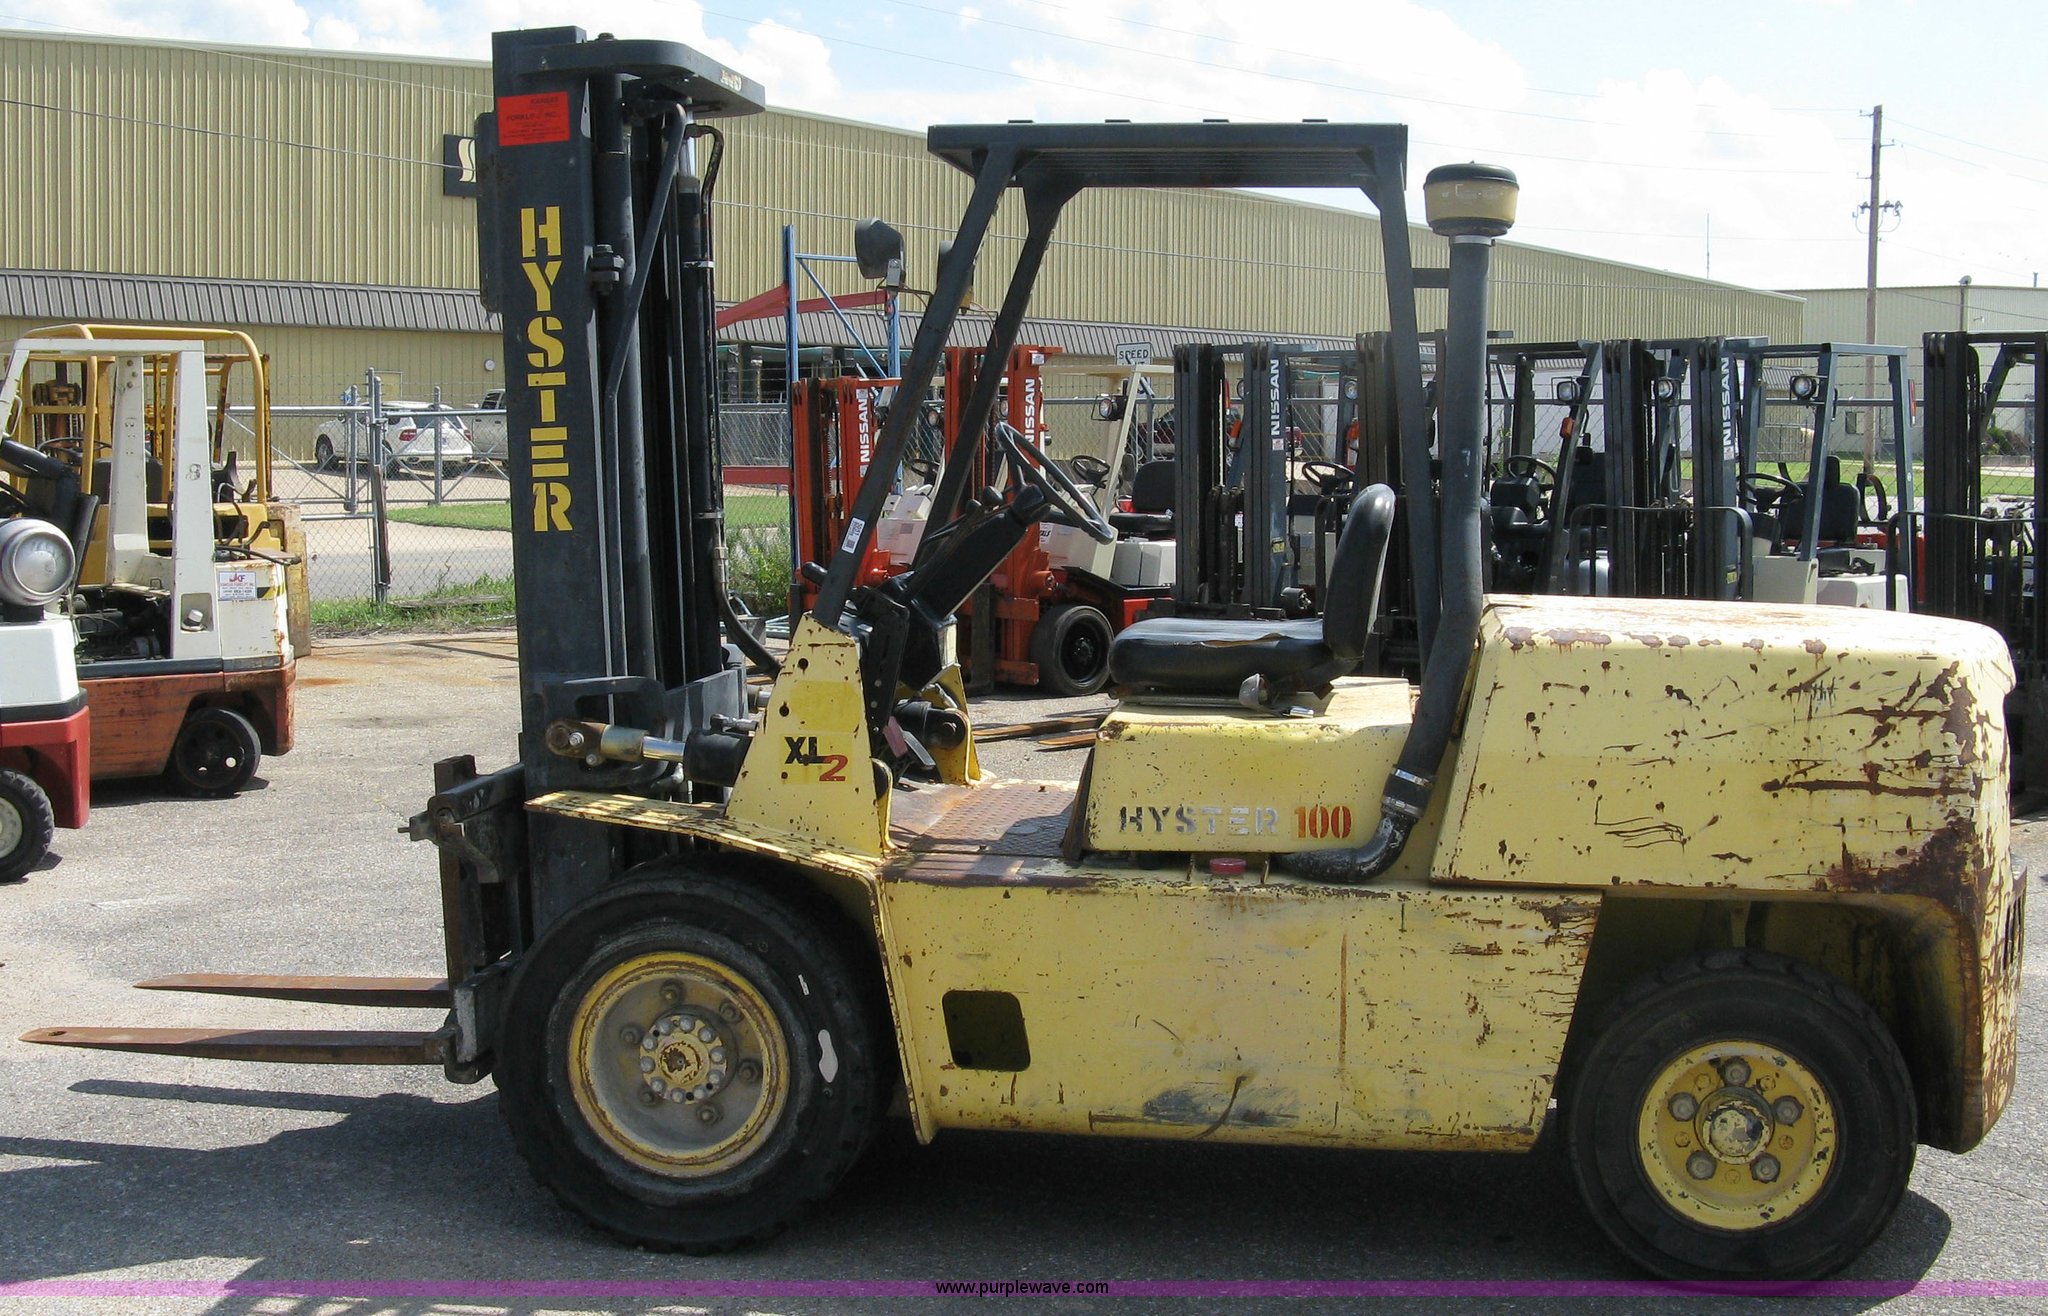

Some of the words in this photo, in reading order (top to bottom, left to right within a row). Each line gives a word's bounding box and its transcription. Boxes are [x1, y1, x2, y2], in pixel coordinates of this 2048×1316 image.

[520, 206, 574, 532] HYSTER
[1119, 349, 1149, 360] SPEED
[858, 398, 870, 463] NISSAN
[1269, 359, 1281, 436] NISSAN
[1720, 357, 1732, 446] NISSAN
[1119, 806, 1280, 834] HYSTER
[1294, 804, 1353, 839] 100
